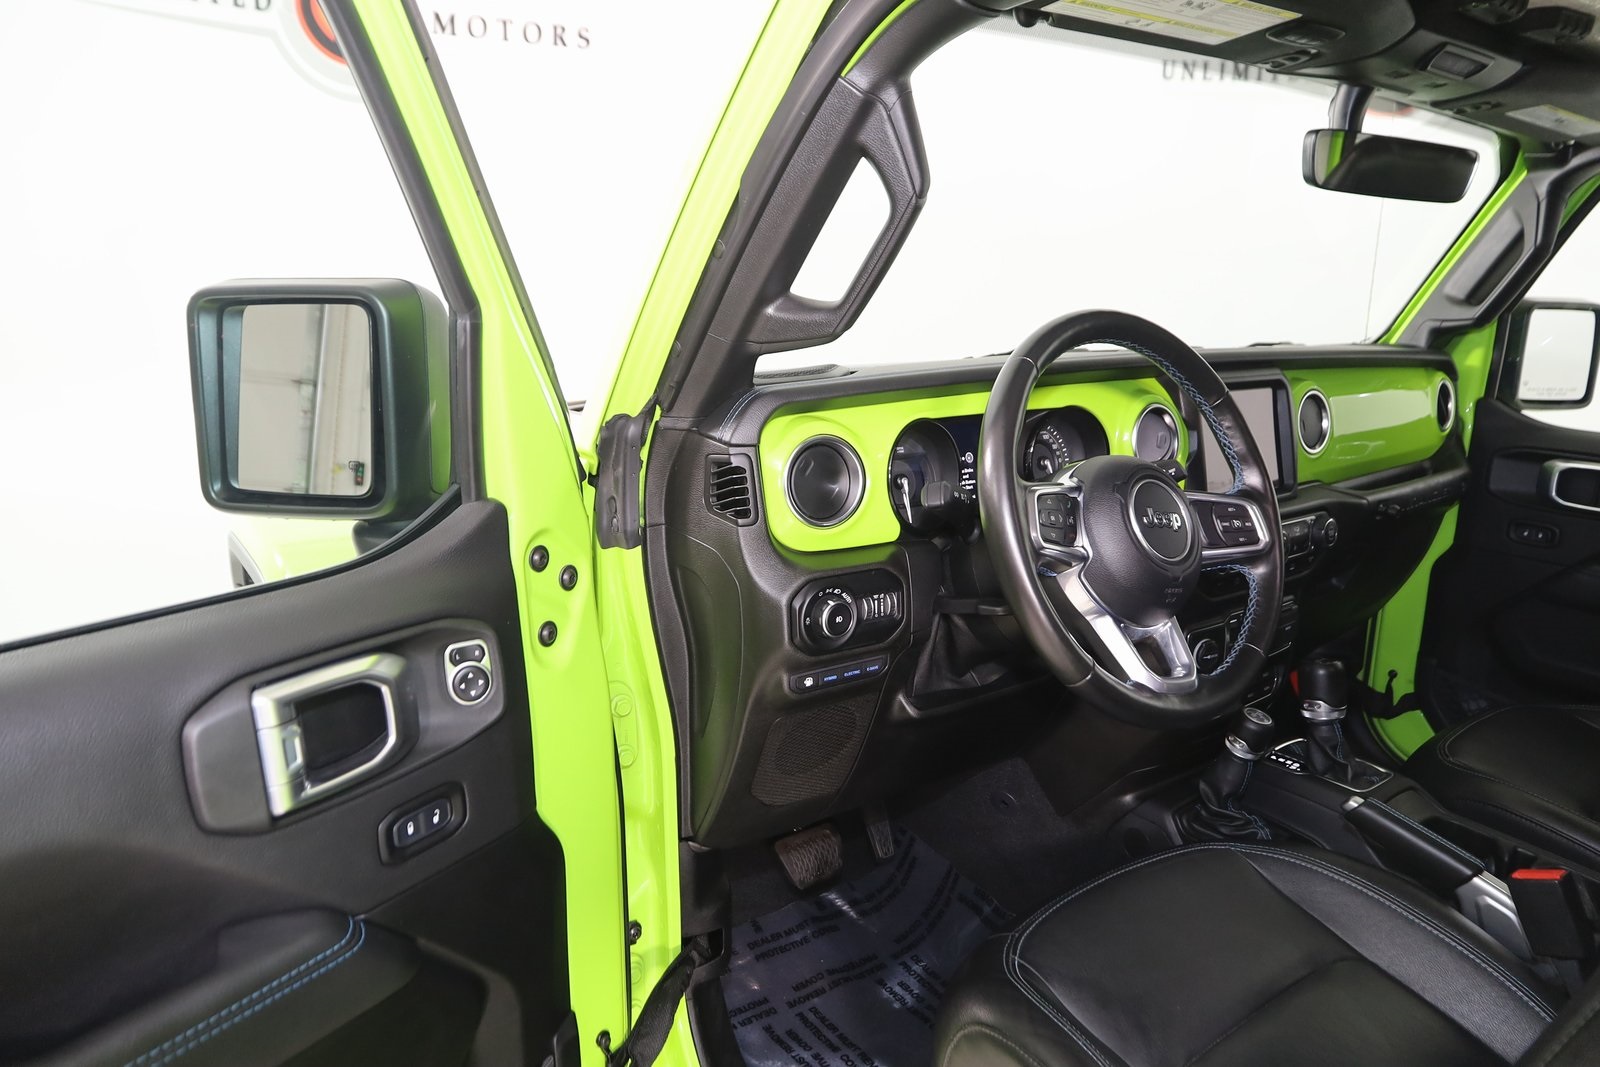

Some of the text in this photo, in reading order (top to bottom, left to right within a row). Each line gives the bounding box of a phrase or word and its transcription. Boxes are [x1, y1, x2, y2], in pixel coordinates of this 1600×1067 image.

[433, 11, 590, 49] MOTORS
[1143, 507, 1181, 531] Jeep
[747, 931, 783, 951] DEALER
[784, 920, 809, 937] MUST
[754, 936, 811, 962] PROTECTIVE
[792, 972, 825, 992] COVER
[785, 987, 827, 1010] REMOVE
[737, 1006, 778, 1028] DEALER
[808, 1006, 839, 1035] DEALER
[836, 1033, 861, 1053] MUST
[762, 1023, 795, 1054] REMOVE
[785, 1027, 812, 1052] COVER
[795, 1011, 842, 1053] PROTECTIVE
